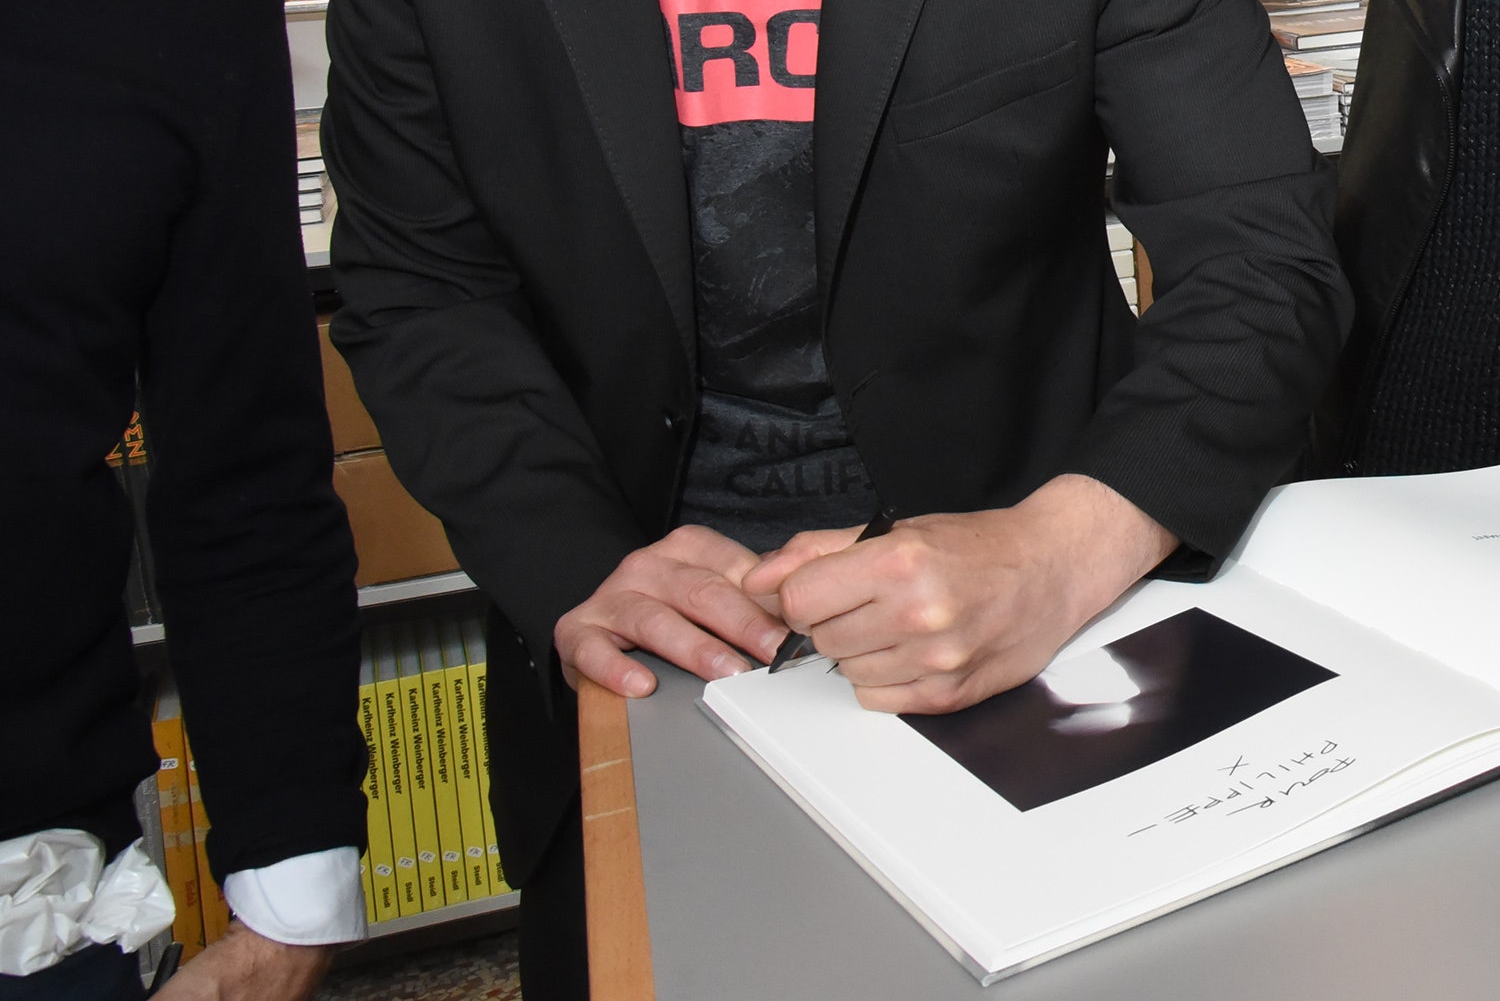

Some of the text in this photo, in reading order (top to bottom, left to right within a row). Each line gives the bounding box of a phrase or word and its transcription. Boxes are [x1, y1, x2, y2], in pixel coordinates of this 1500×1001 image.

[662, 9, 822, 93] RC
[724, 461, 874, 498] CALIF
[362, 697, 373, 743] Karlheinz
[408, 688, 426, 789] Karlheinz Weinberger
[431, 682, 448, 784] Karlheinz Weinberger
[454, 678, 471, 779] Karlheinz Weinberger
[385, 692, 402, 794] Karlheinz Weinberger
[405, 881, 413, 902] Steidl
[428, 876, 436, 897] Steidl
[451, 870, 459, 891] Steidl
[473, 865, 482, 886] Steidl
[382, 886, 391, 908] Steidl
